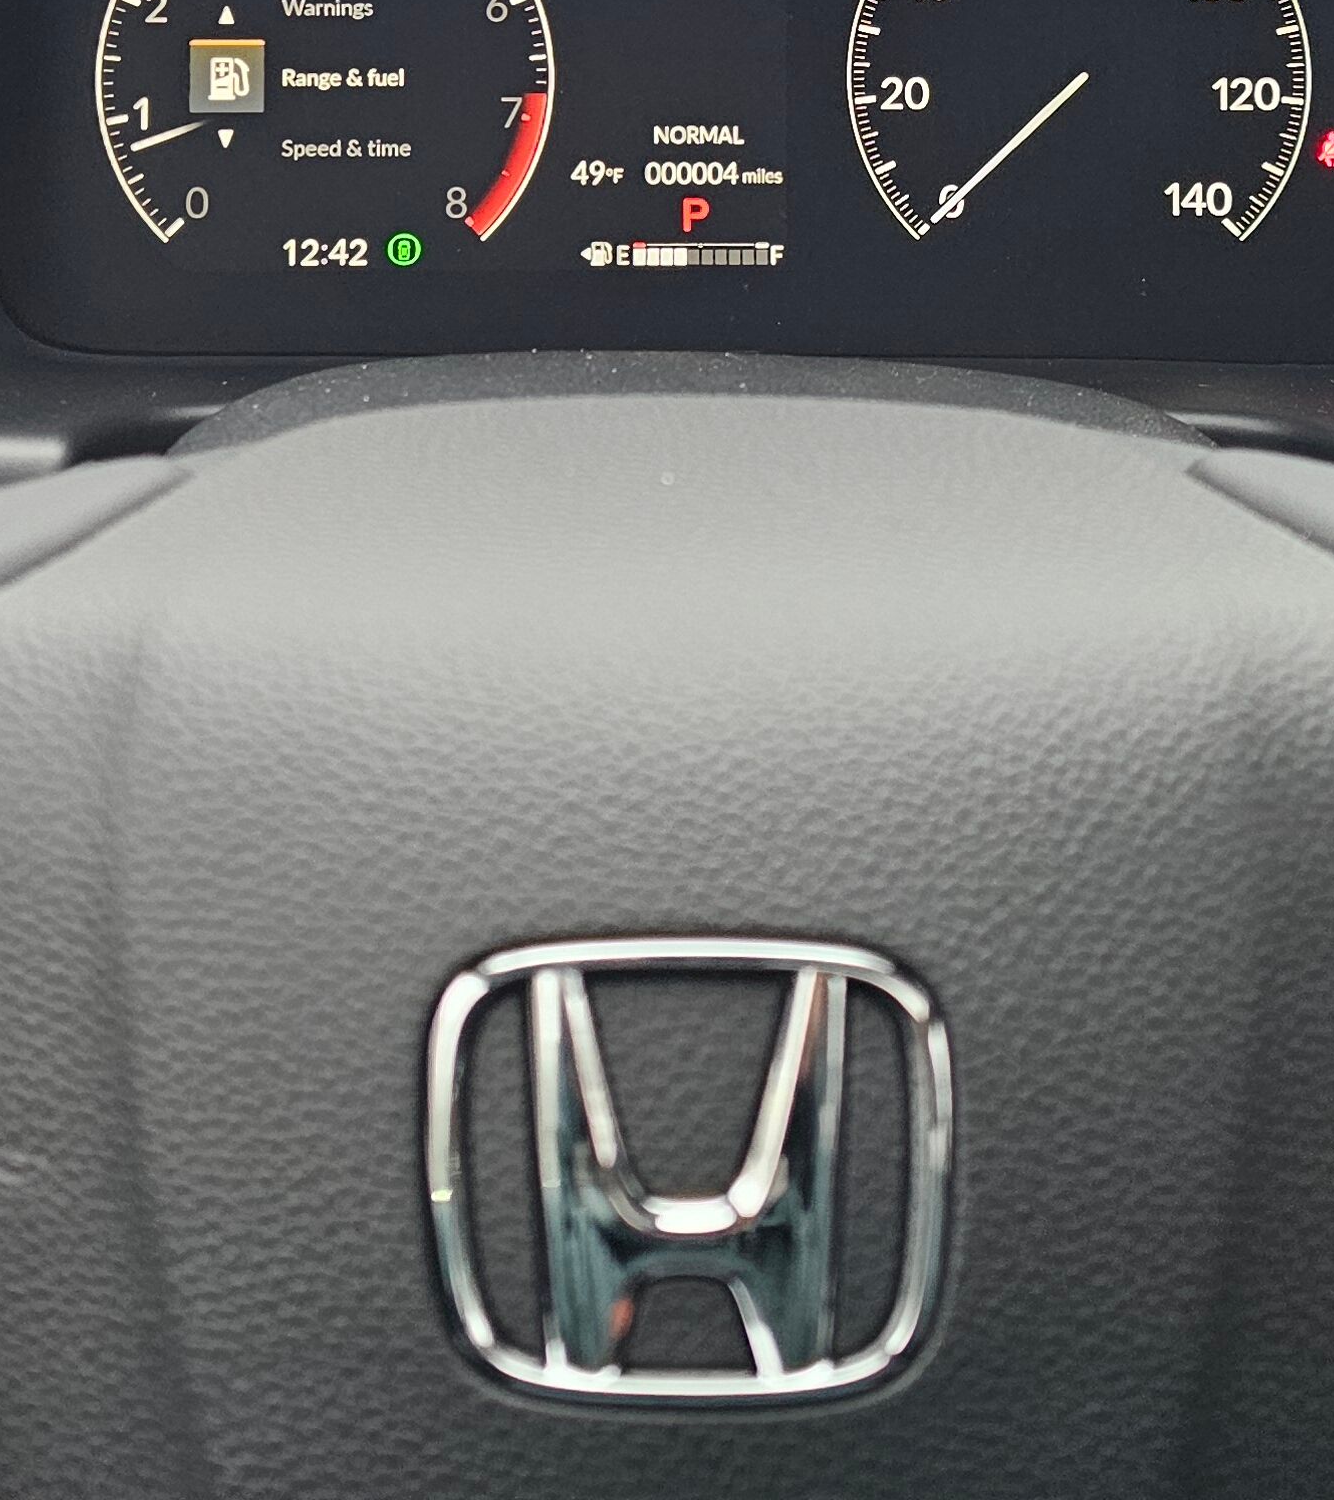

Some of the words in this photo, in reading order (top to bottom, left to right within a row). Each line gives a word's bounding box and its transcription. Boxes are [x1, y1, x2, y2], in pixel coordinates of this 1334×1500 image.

[282, 0, 374, 20] Warnings
[282, 68, 342, 90] Range
[346, 68, 363, 87] &
[367, 68, 405, 87] fuel
[880, 78, 929, 110] 20
[1212, 78, 1281, 110] 120
[132, 99, 149, 129] 1
[500, 98, 522, 128] 7
[653, 125, 745, 145] NORMAL
[281, 139, 342, 161] Speed
[347, 139, 362, 157] &
[367, 139, 412, 157] time
[644, 161, 739, 185] 000004
[742, 168, 784, 185] miles
[185, 189, 209, 218] 0
[445, 187, 467, 218] 8
[1165, 184, 1232, 216] 140
[682, 197, 710, 233] P
[283, 239, 368, 266] 12:42
[617, 245, 630, 265] E
[770, 245, 784, 265] F
